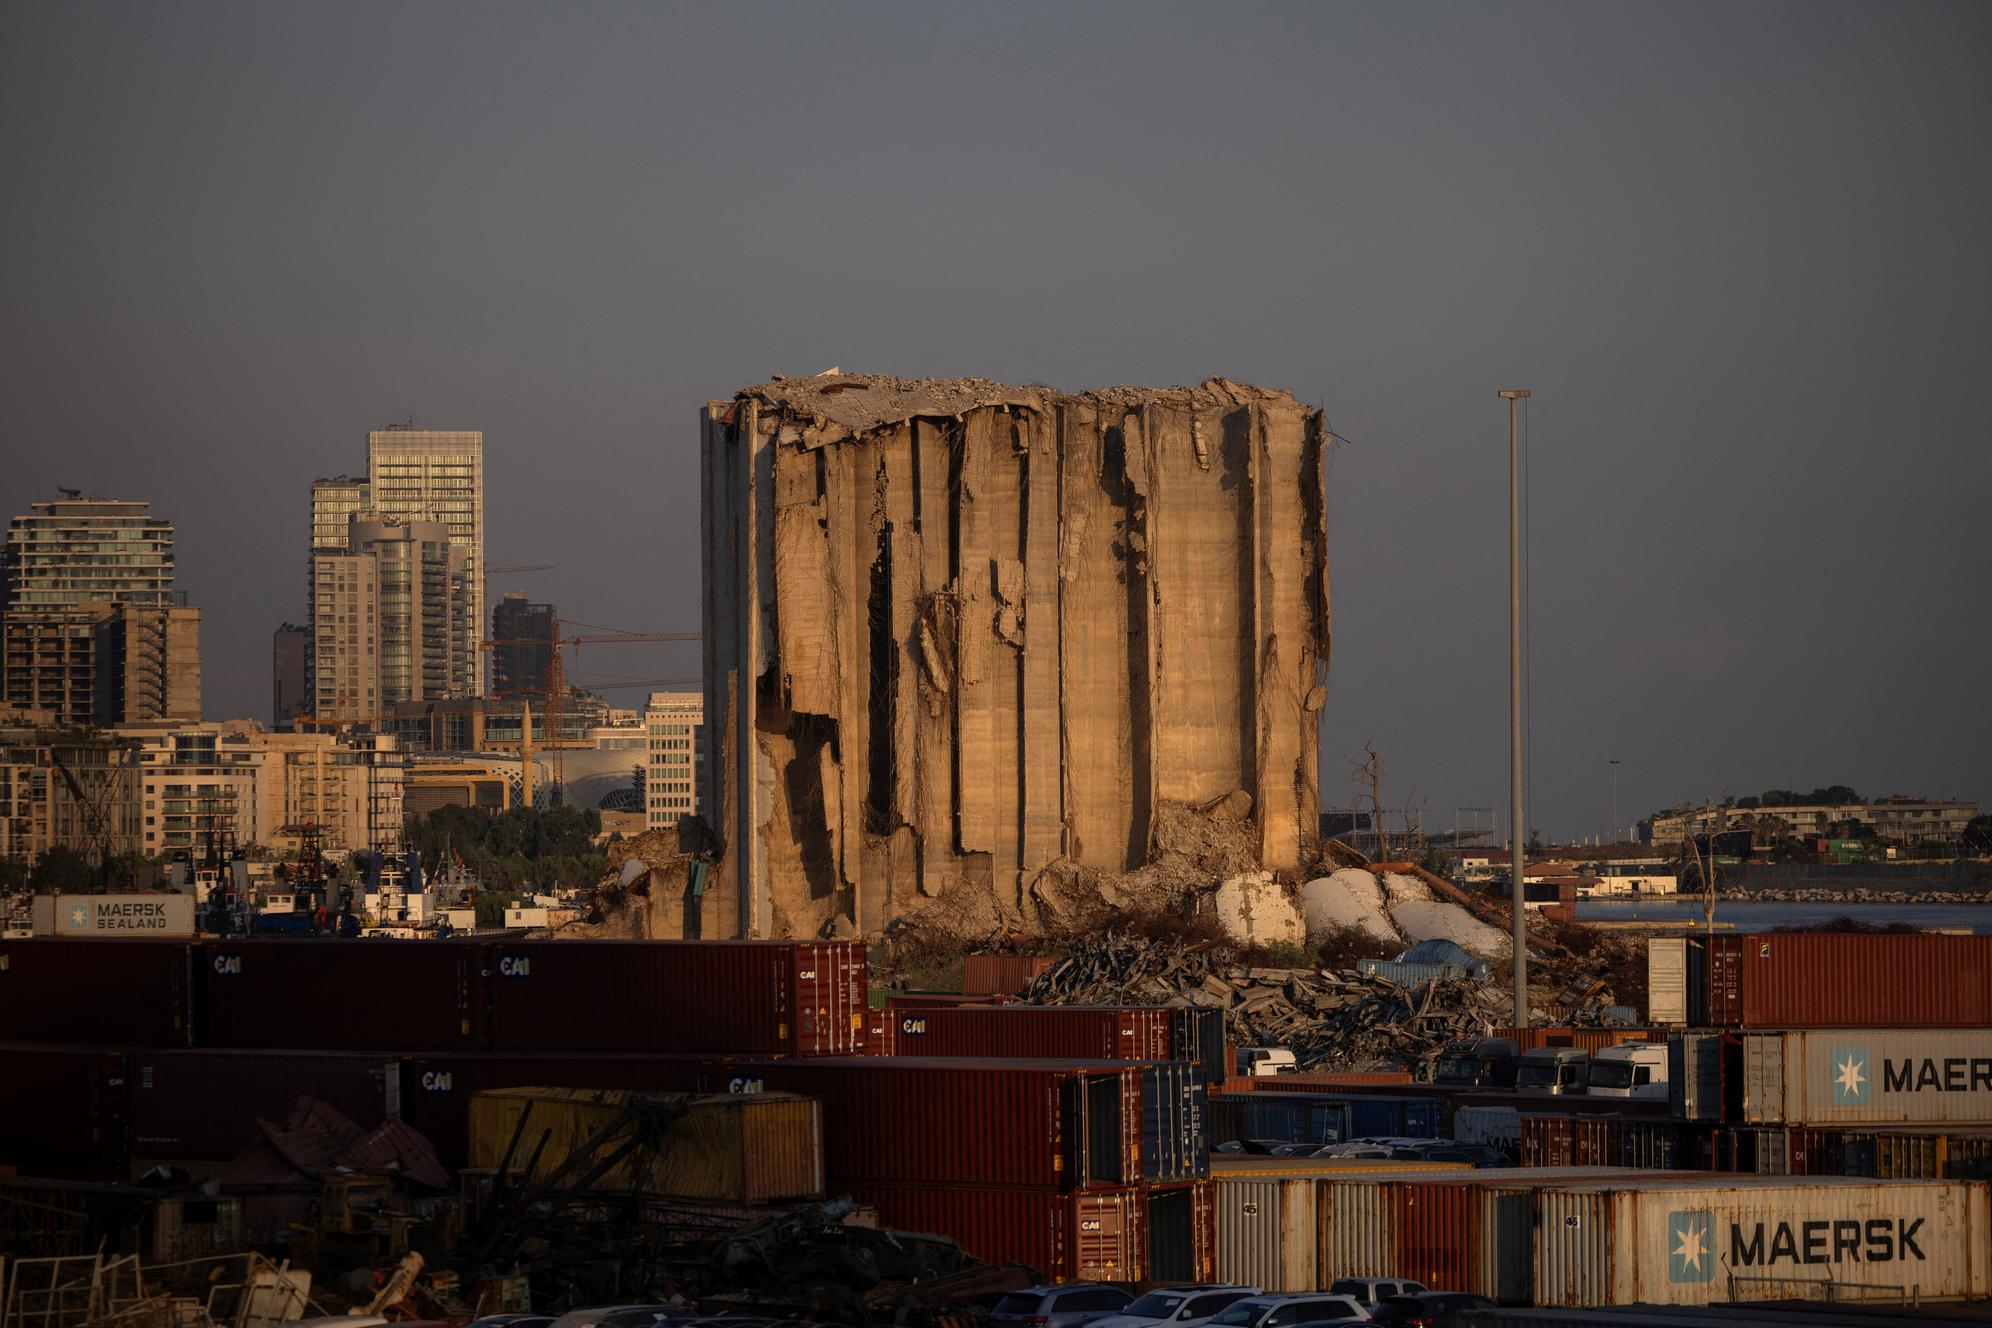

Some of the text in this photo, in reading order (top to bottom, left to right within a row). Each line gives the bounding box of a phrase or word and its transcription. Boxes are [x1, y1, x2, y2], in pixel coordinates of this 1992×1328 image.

[98, 904, 166, 917] MAERSK
[97, 918, 167, 928] SEALAND
[214, 955, 241, 975] CAI
[500, 956, 530, 976] CAI
[800, 971, 815, 979] CAI
[903, 1018, 926, 1034] CAI
[422, 1072, 452, 1090] CAI
[1884, 1058, 1992, 1092] MAER
[729, 1078, 763, 1094] CAI
[1242, 1204, 1256, 1215] 45
[1082, 1222, 1100, 1230] CAI
[1566, 1216, 1578, 1227] 45
[1731, 1218, 1926, 1267] MAERSK
